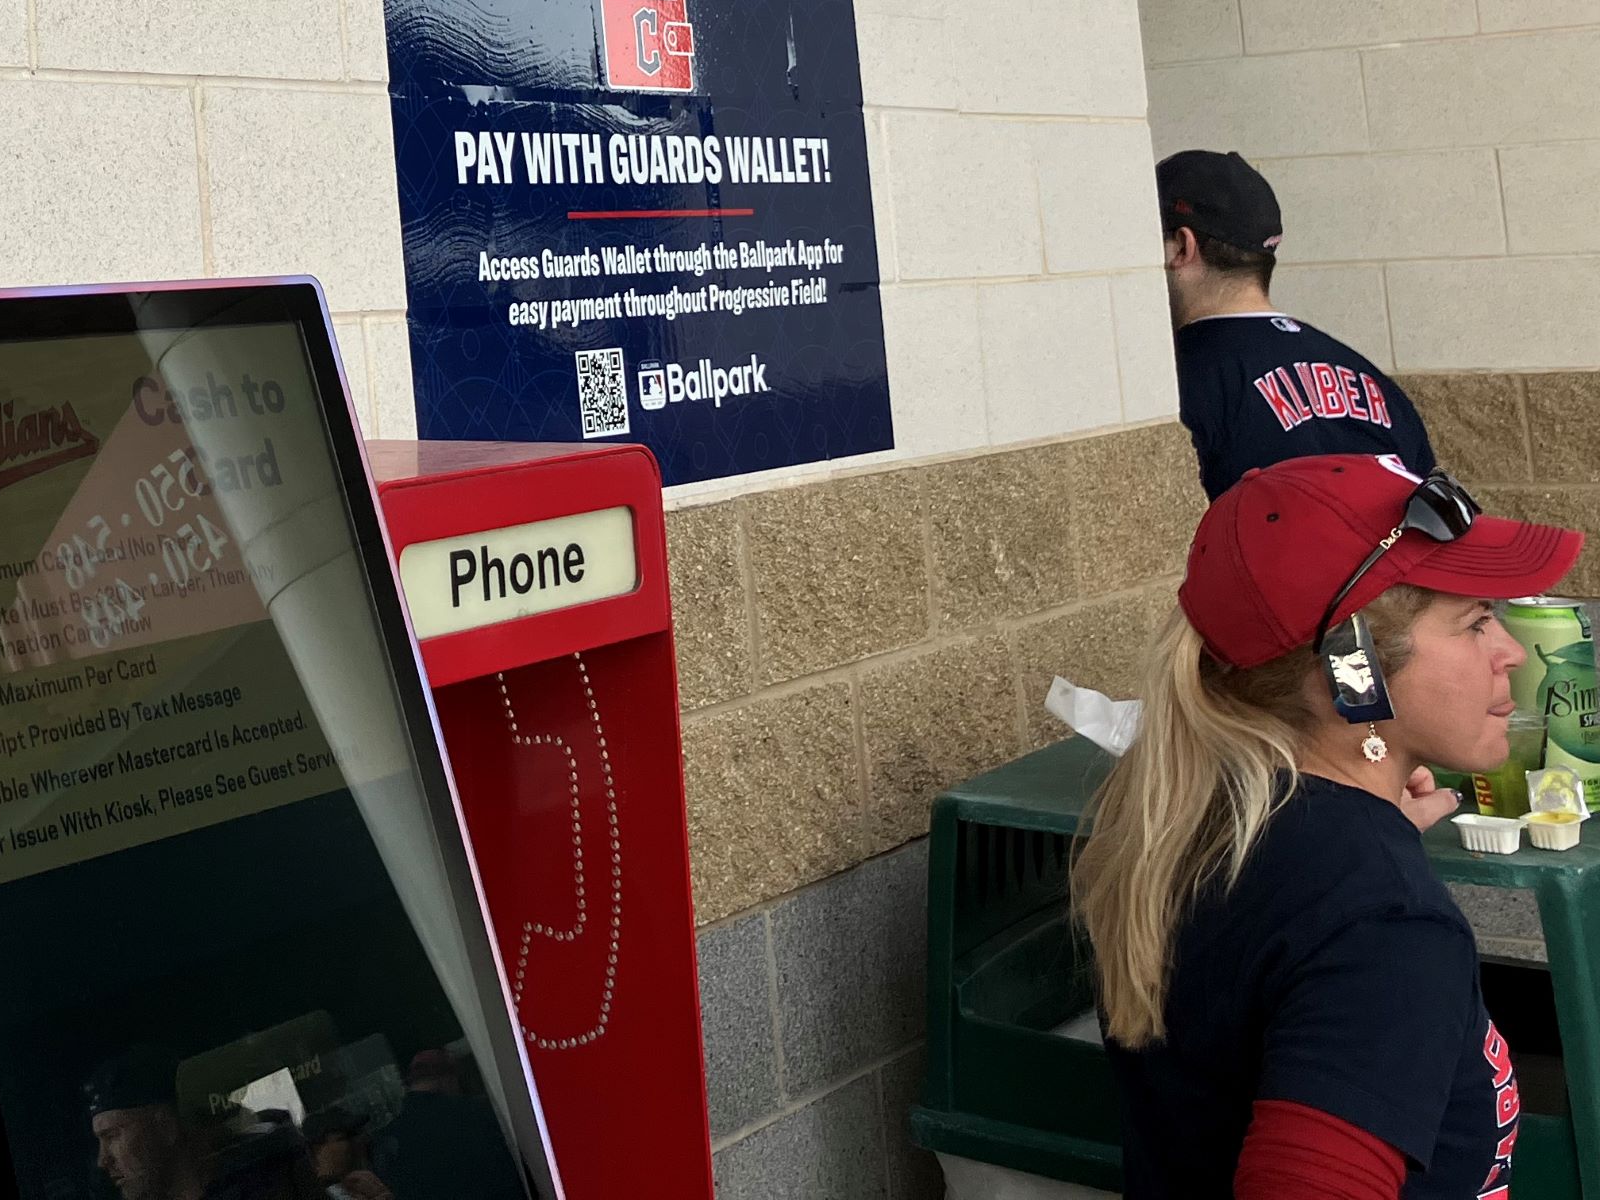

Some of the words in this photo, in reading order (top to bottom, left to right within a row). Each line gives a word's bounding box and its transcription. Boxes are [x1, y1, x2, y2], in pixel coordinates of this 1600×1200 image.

[454, 131, 515, 185] PAY
[520, 132, 604, 185] WITH
[608, 133, 724, 185] GUARDS
[724, 136, 832, 184] WALLET!
[478, 250, 539, 282] Access
[542, 247, 600, 279] Guards
[601, 244, 652, 276] Wallet
[652, 242, 712, 277] through
[712, 241, 738, 270] the
[739, 239, 796, 273] Ballpark
[798, 239, 824, 271] App
[823, 237, 844, 264] for
[508, 300, 549, 330] easy
[550, 294, 623, 329] payment
[624, 285, 708, 321] throughout
[709, 280, 790, 316] Progressive
[791, 277, 828, 305] Field!
[132, 370, 238, 427] Cash
[241, 373, 286, 415] to
[666, 354, 769, 408] Ballpark
[42, 544, 84, 572] Cad
[1379, 527, 1402, 550] D&G
[23, 596, 67, 623] Must
[152, 573, 206, 599] Larger,
[209, 568, 245, 588] Then
[450, 543, 585, 607] Phone
[84, 665, 113, 688] Per
[117, 657, 158, 681] Card
[28, 710, 106, 748] Provided
[107, 706, 131, 731] By
[132, 700, 170, 723] Text
[171, 685, 242, 715] Message
[30, 760, 116, 796] Wherever
[117, 731, 213, 775] Mastercard
[215, 731, 230, 750] Is
[232, 711, 309, 747] Accepted.
[9, 822, 60, 851] Issue
[60, 808, 103, 837] With
[104, 794, 158, 827] Kiosk,
[158, 783, 214, 811] Please
[215, 773, 248, 795] See
[248, 759, 296, 787] Guest
